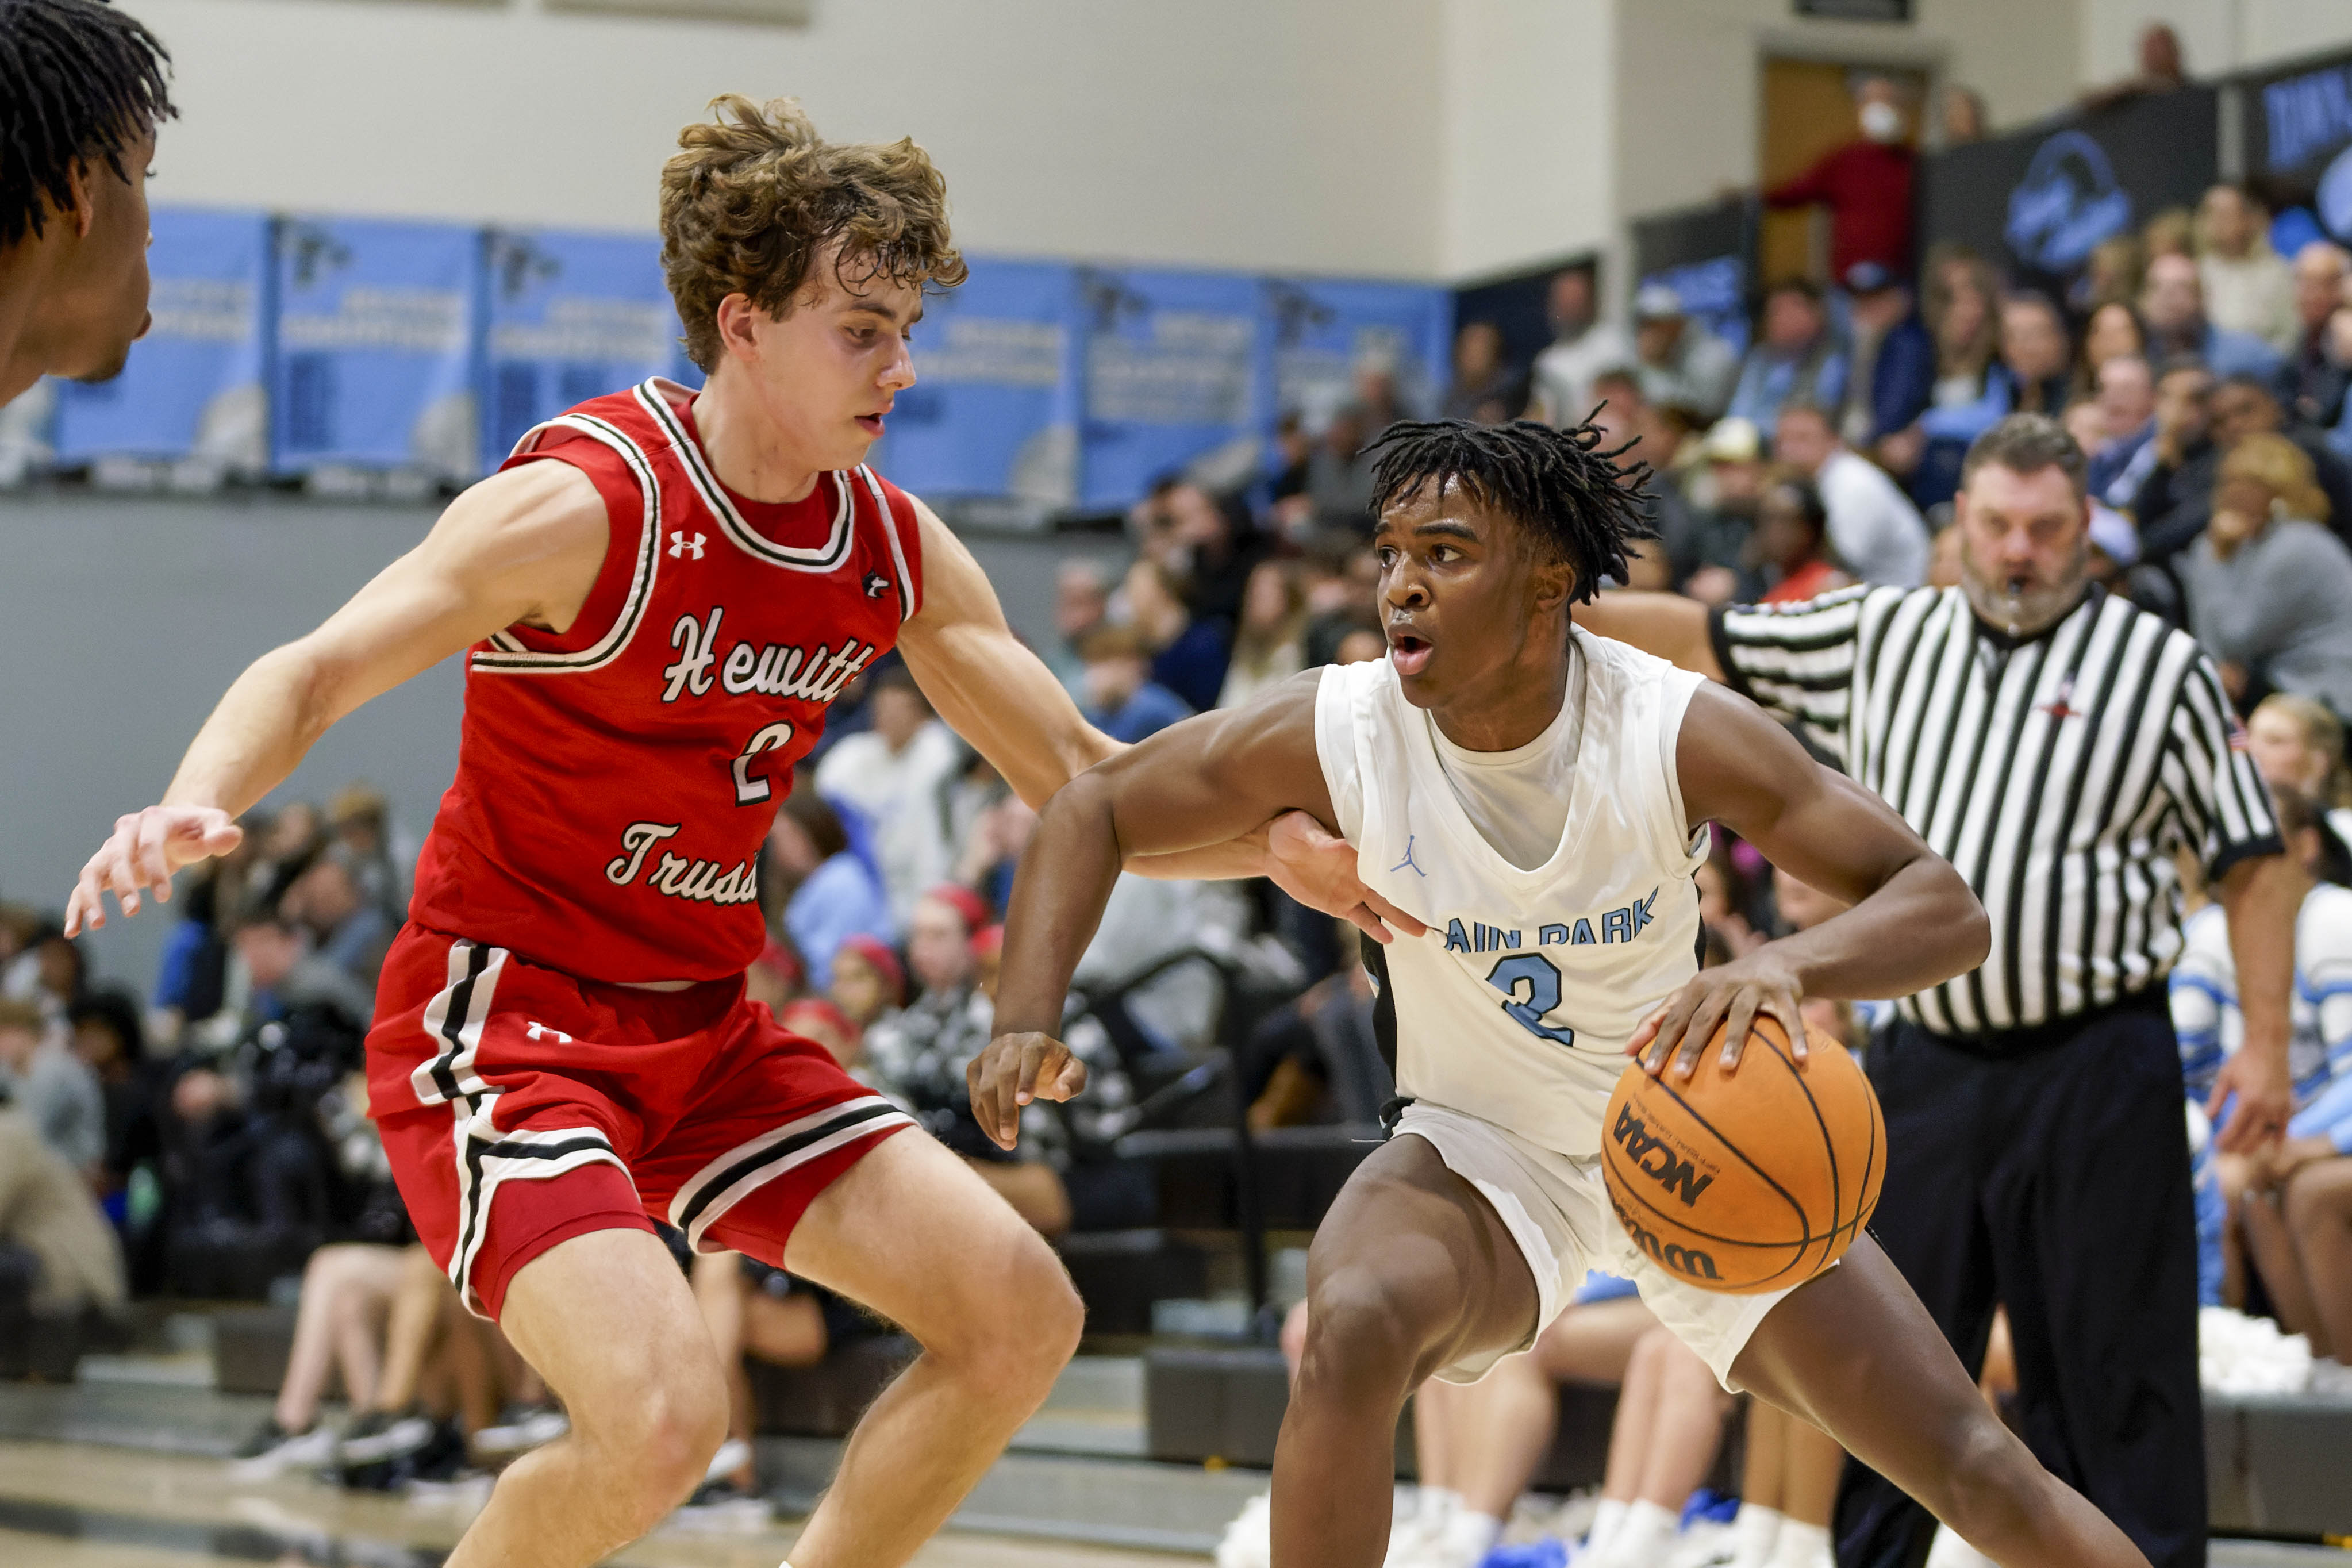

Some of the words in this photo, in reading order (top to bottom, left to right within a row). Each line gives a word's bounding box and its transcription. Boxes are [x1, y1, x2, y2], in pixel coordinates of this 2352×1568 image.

[661, 605, 875, 703] Hewitt
[730, 720, 795, 806] 2
[1436, 917, 1521, 954] AIN
[1539, 885, 1659, 946] PARK
[1485, 952, 1575, 1047] 2
[1613, 1100, 1715, 1208] NCAA
